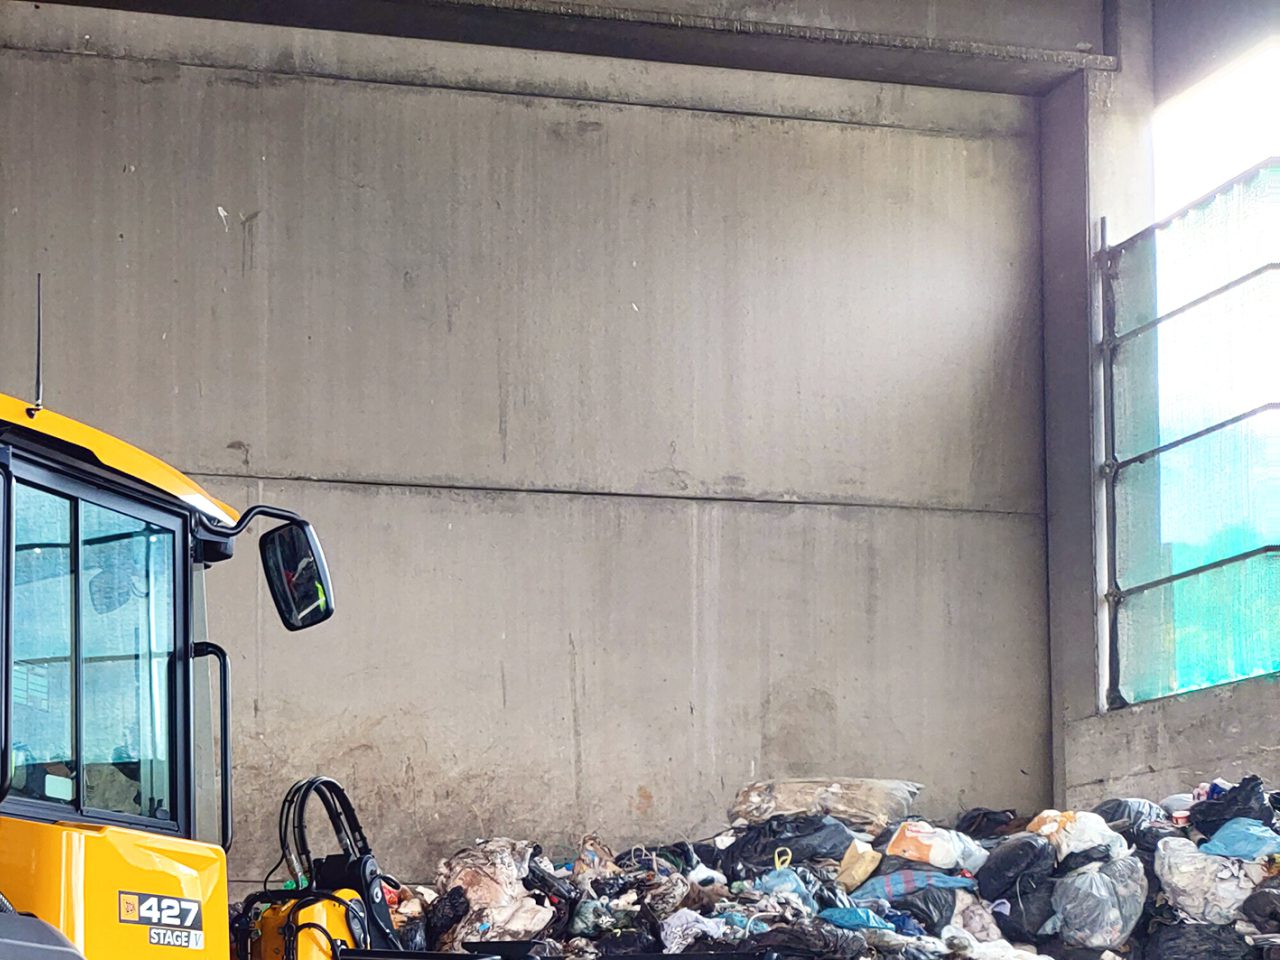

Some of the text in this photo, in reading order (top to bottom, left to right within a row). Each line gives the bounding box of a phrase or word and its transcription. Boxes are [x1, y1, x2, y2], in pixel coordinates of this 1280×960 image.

[139, 896, 199, 927] 427
[150, 928, 201, 948] STAGE V
